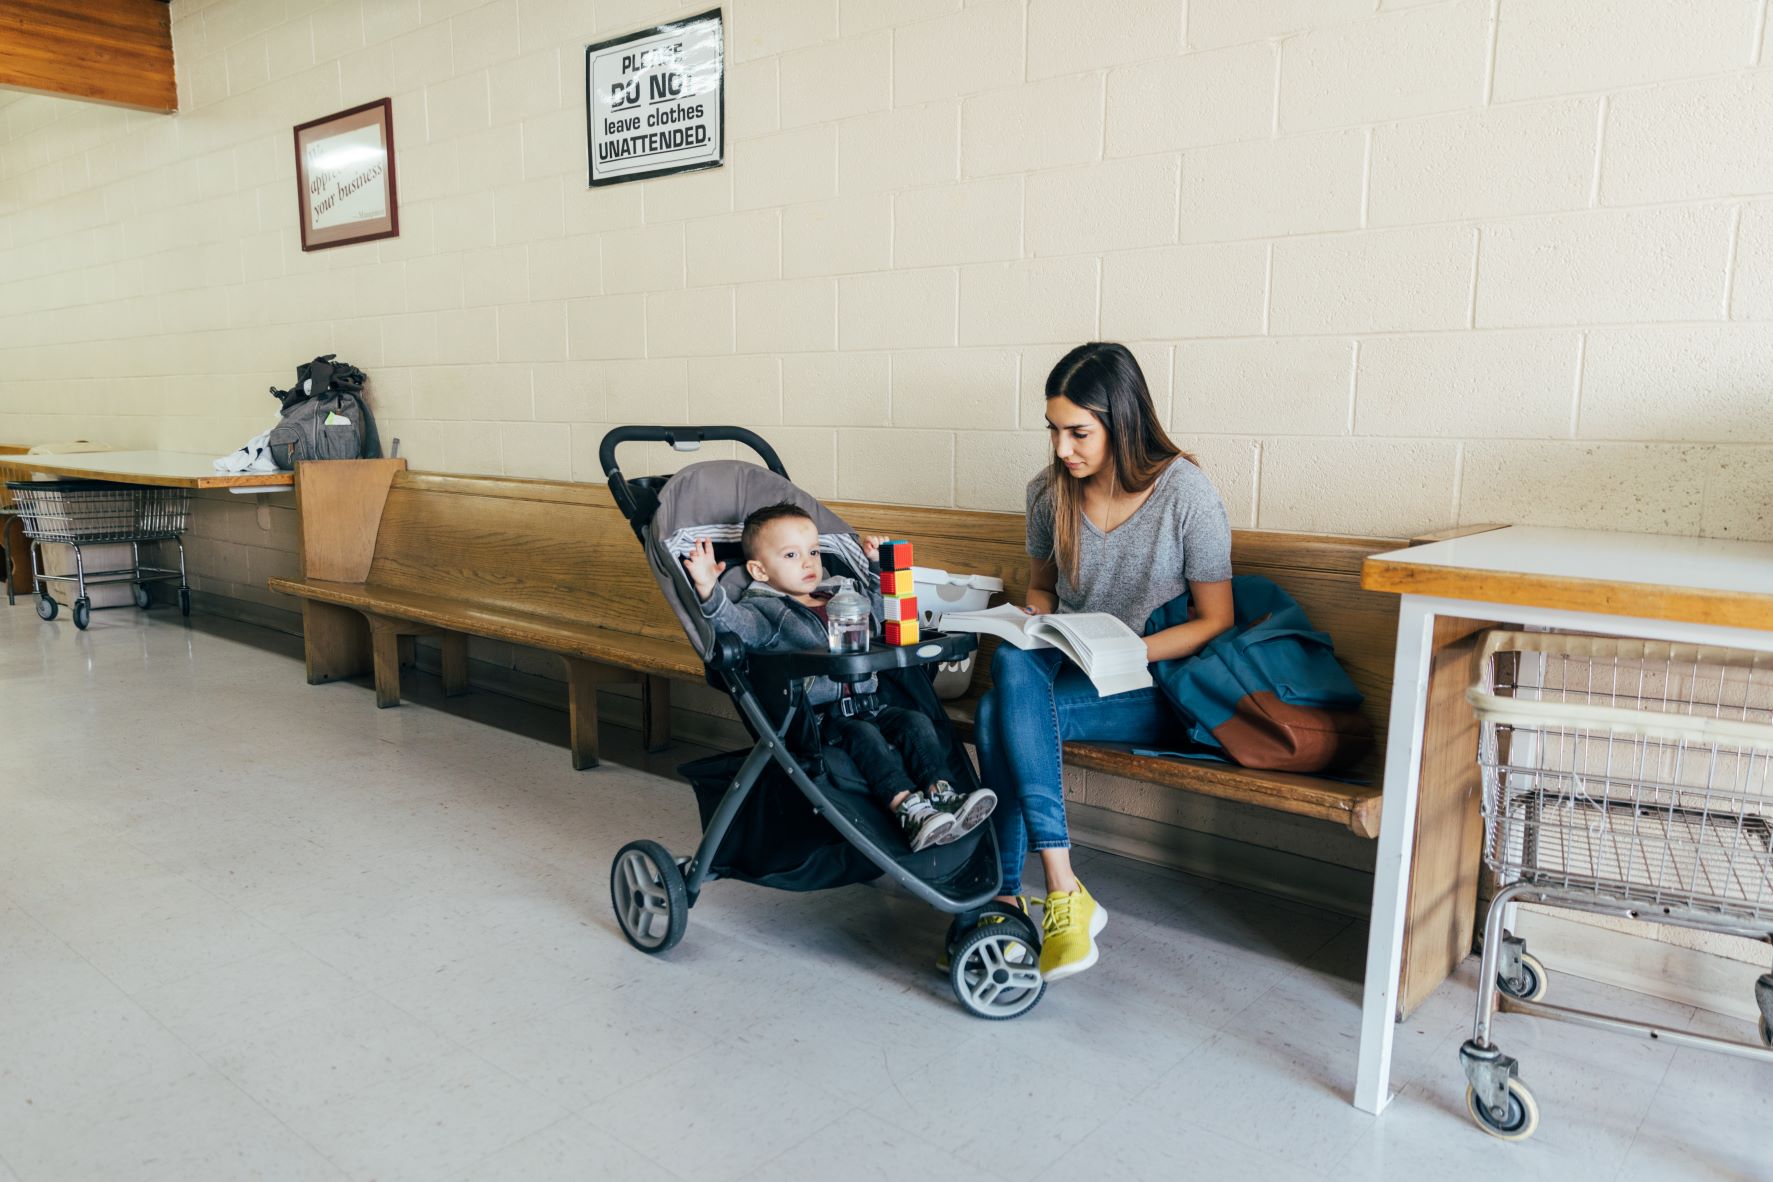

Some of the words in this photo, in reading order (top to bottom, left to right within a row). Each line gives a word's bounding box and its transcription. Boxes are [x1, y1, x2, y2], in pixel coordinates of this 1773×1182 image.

[611, 79, 641, 108] DO
[649, 70, 694, 101] NO
[604, 116, 641, 136] leave
[647, 103, 704, 128] clothes
[599, 124, 711, 161] UNATTENDED.
[314, 193, 336, 223] your
[337, 162, 384, 201] business
